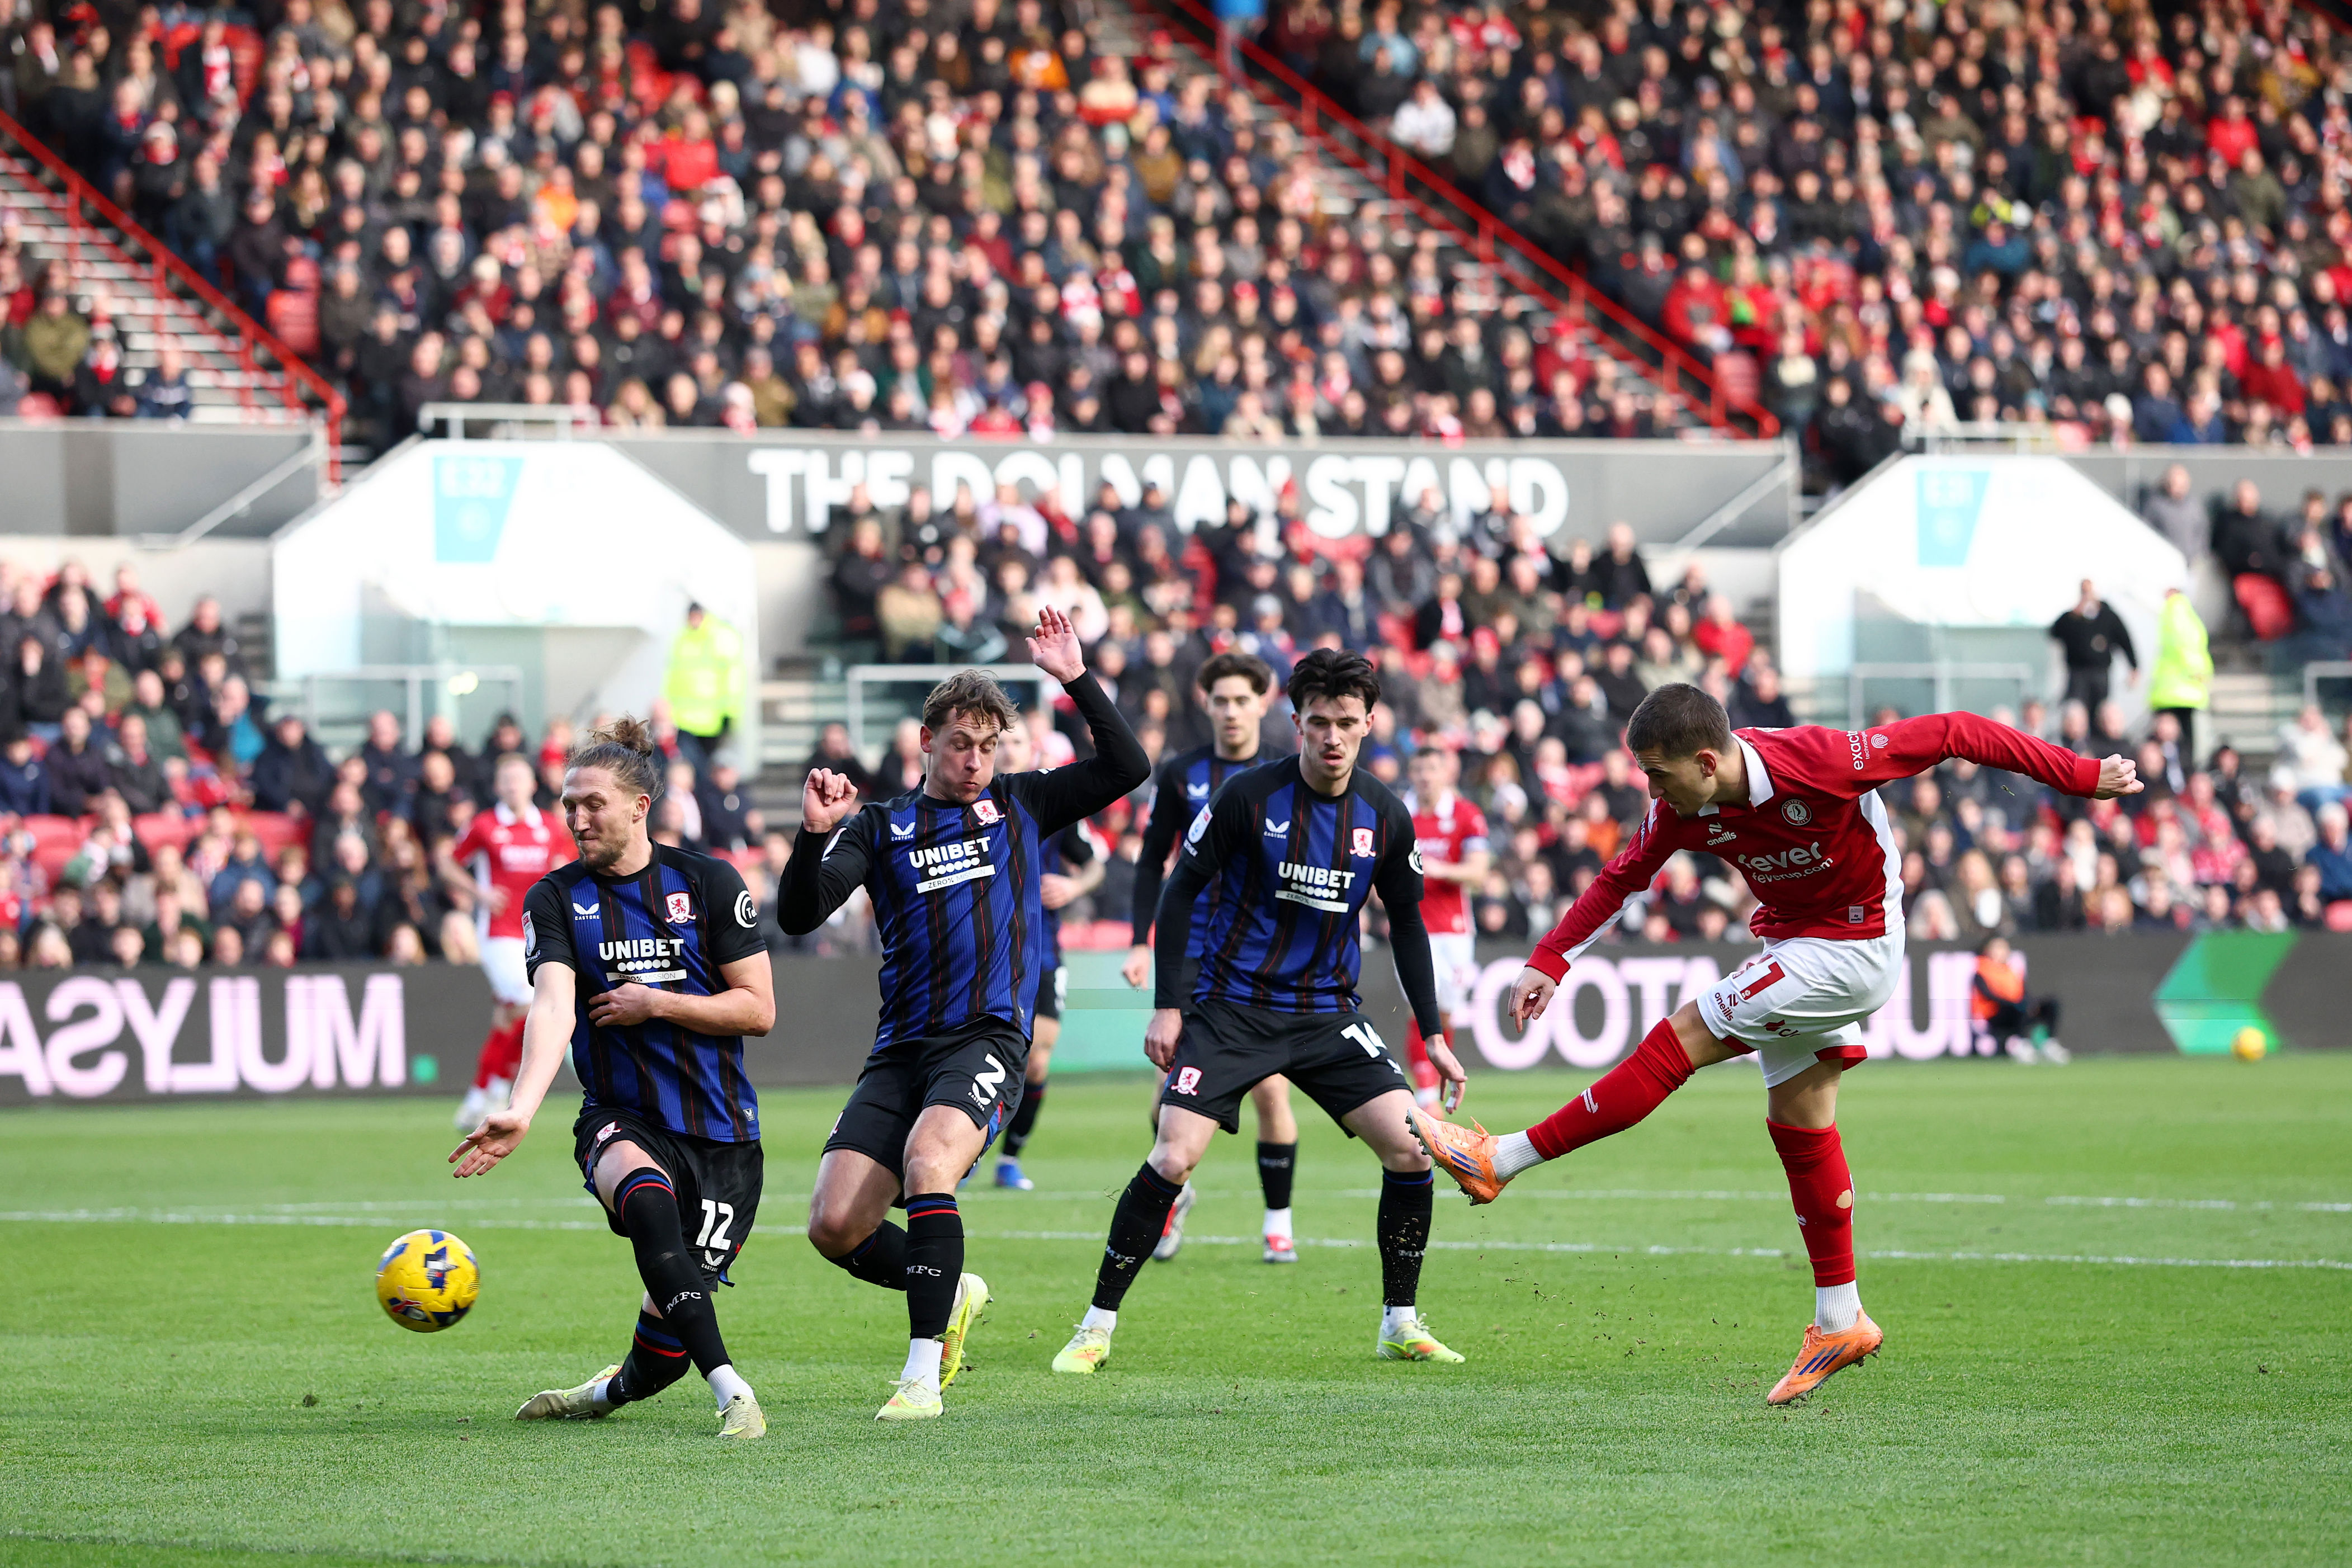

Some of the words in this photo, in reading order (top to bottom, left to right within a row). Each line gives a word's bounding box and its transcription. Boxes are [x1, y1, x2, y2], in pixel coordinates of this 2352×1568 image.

[748, 447, 914, 534] THE
[1846, 730, 1864, 770] exact
[909, 836, 991, 868] UNIBET
[956, 868, 986, 881] MISSION
[1278, 861, 1356, 889] UNIBET
[598, 939, 684, 961] UNIBET
[645, 972, 676, 981] MISSION
[975, 1053, 1006, 1099] 2
[696, 1198, 734, 1250] 12
[906, 1265, 942, 1277] MFC
[665, 1291, 702, 1314] MFC
